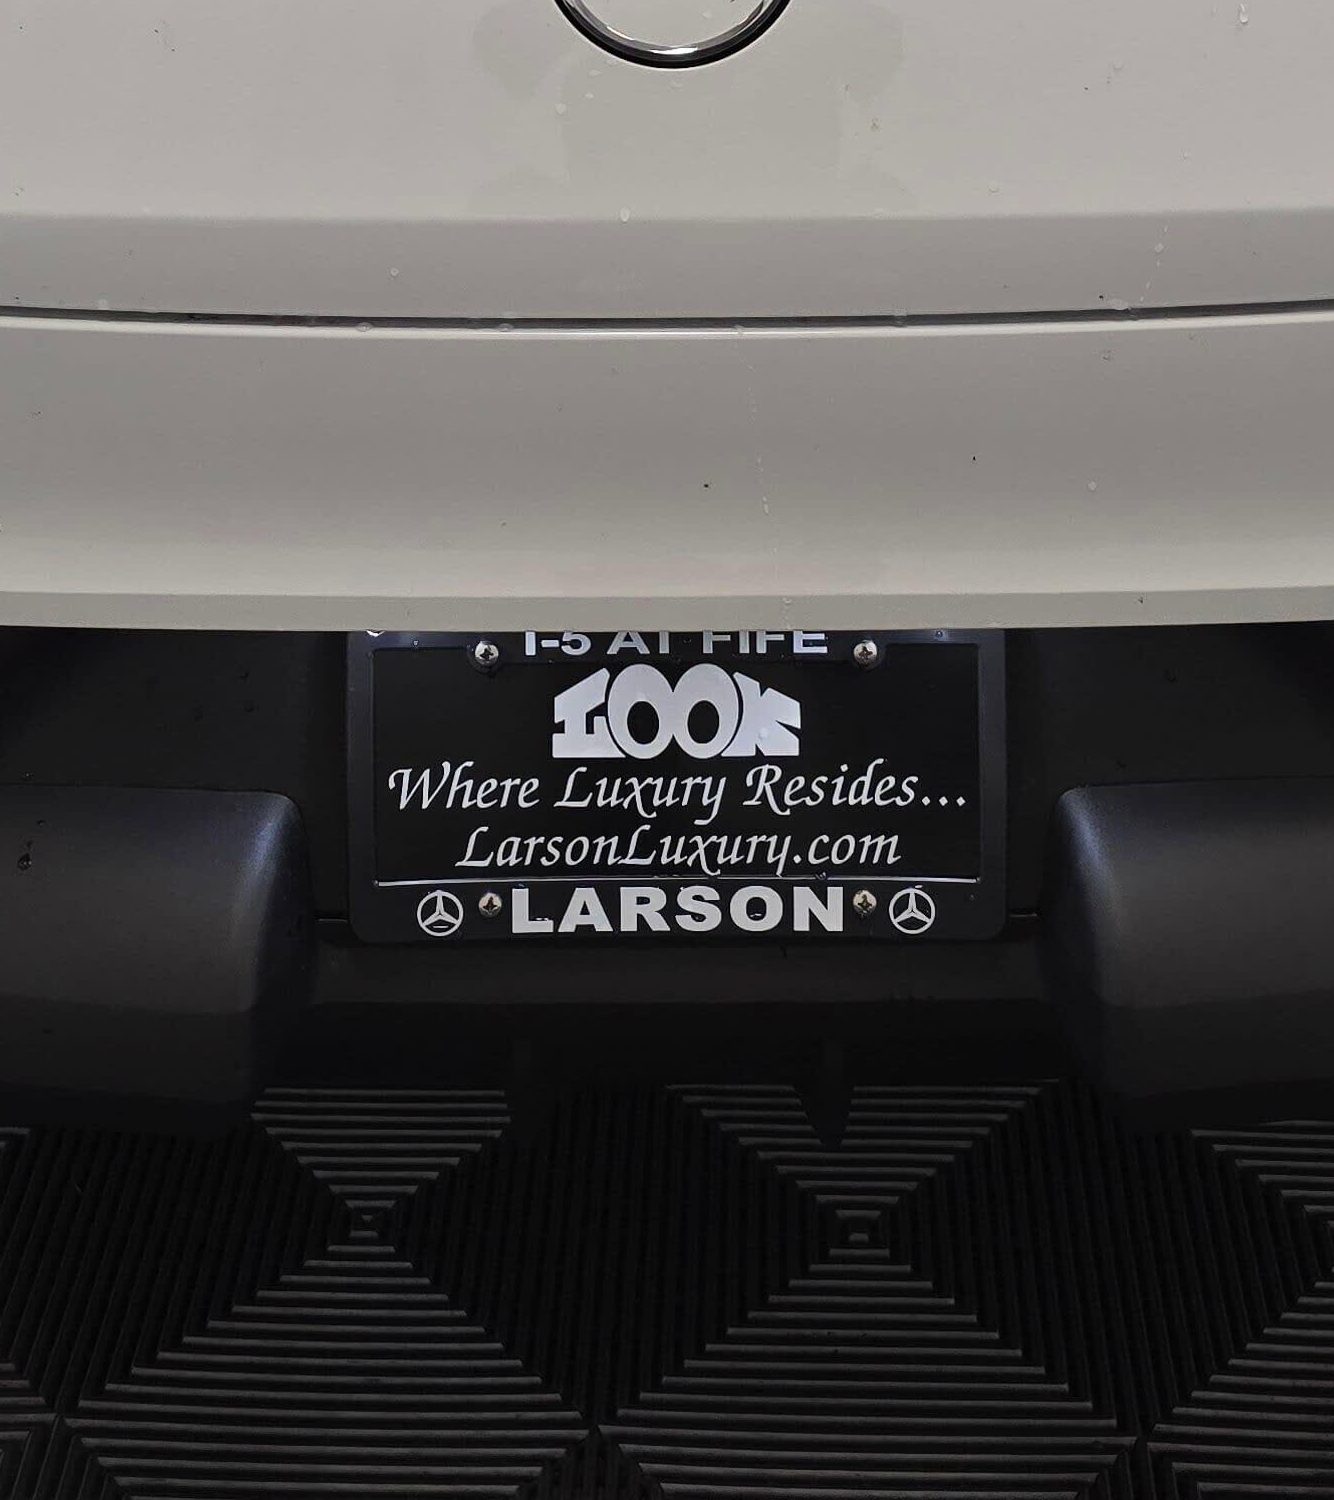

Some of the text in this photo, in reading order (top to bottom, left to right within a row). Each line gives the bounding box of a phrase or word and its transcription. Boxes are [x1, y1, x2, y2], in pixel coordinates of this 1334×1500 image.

[525, 631, 592, 656] I-5
[702, 631, 828, 654] FIFE
[552, 664, 801, 759] LOOK
[389, 758, 965, 825] Where Luxury Resides...
[455, 825, 901, 874] LarsonLuxury.com
[512, 886, 843, 933] LARSON
